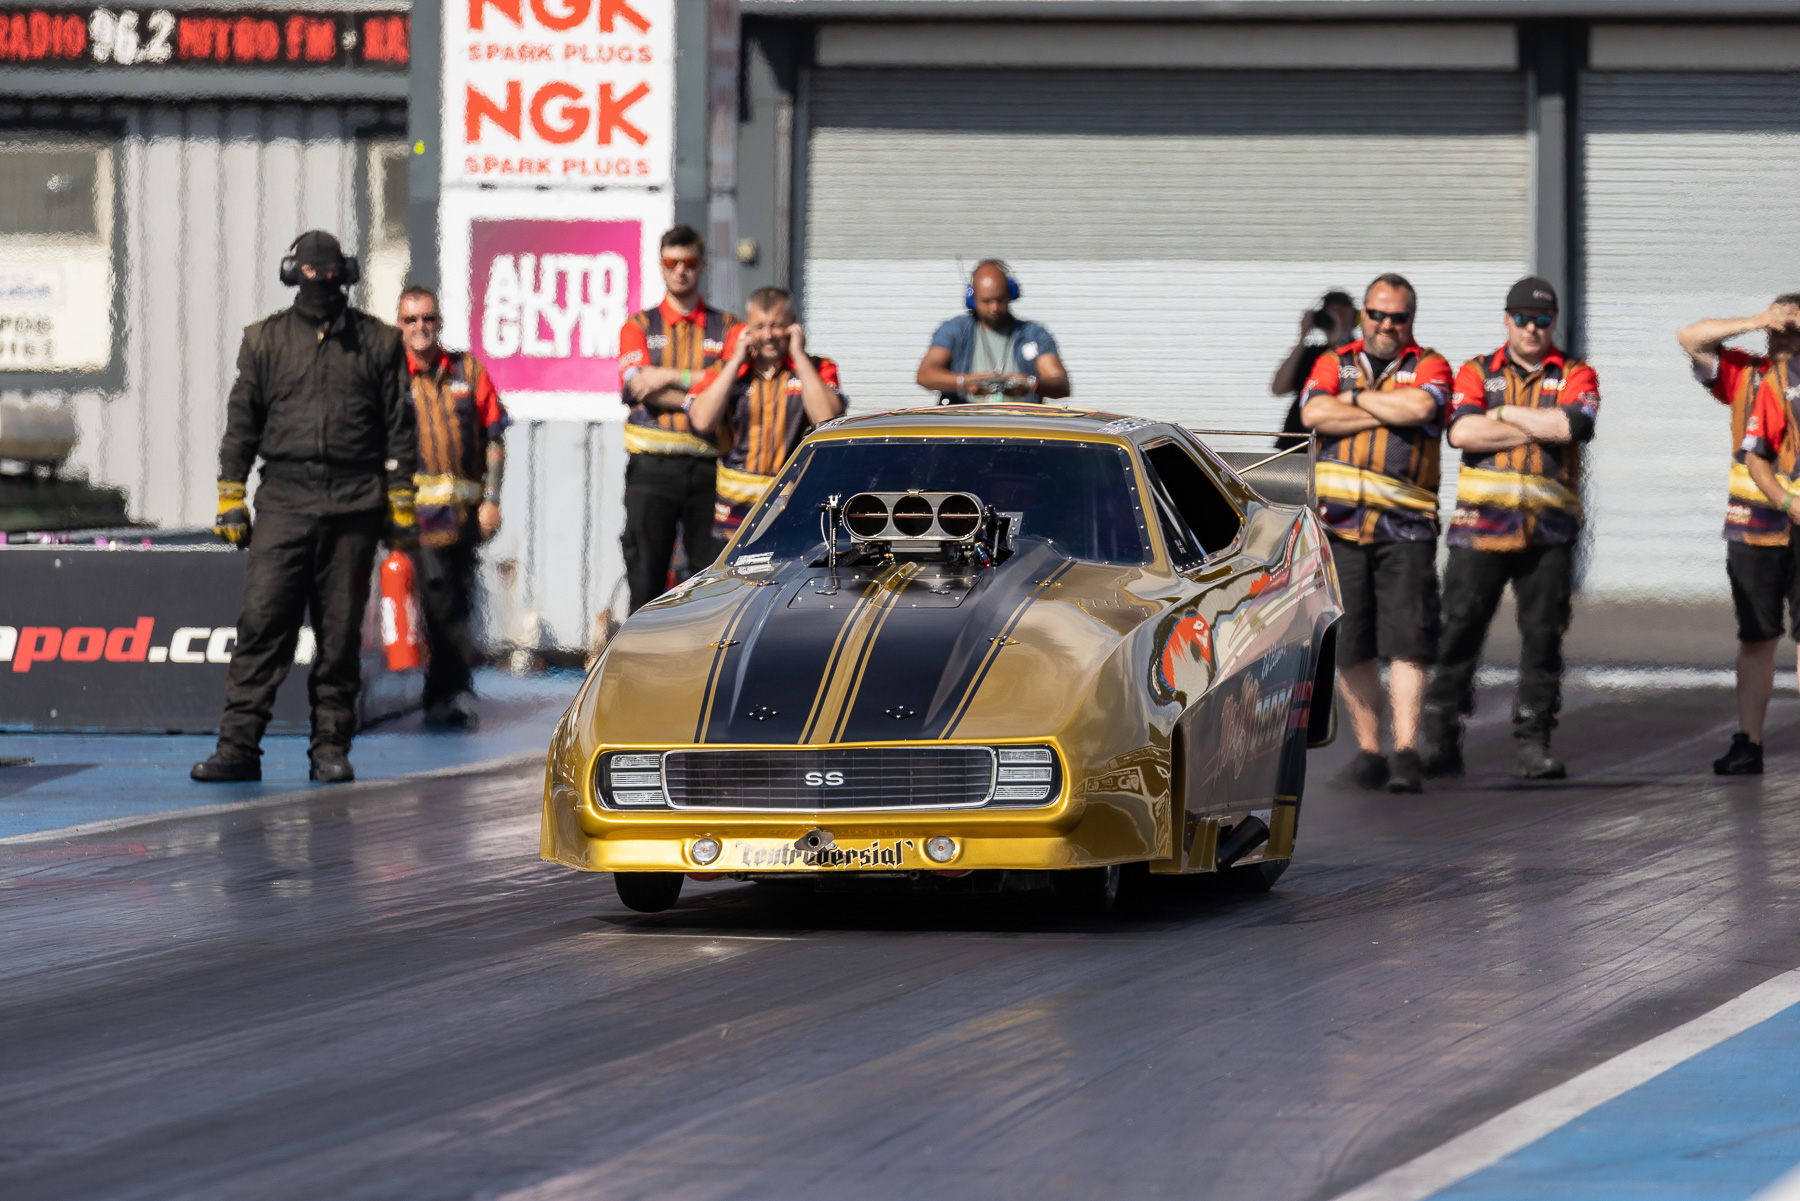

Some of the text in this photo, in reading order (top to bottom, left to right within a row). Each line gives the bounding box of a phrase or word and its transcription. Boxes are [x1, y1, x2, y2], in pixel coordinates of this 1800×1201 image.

[467, 42, 652, 63] SPARK PLUGS
[465, 79, 651, 146] NGK
[464, 155, 649, 176] SPARK PLUGS
[484, 251, 629, 304] AUTO
[0, 616, 316, 672] pod.co
[805, 771, 844, 786] SS
